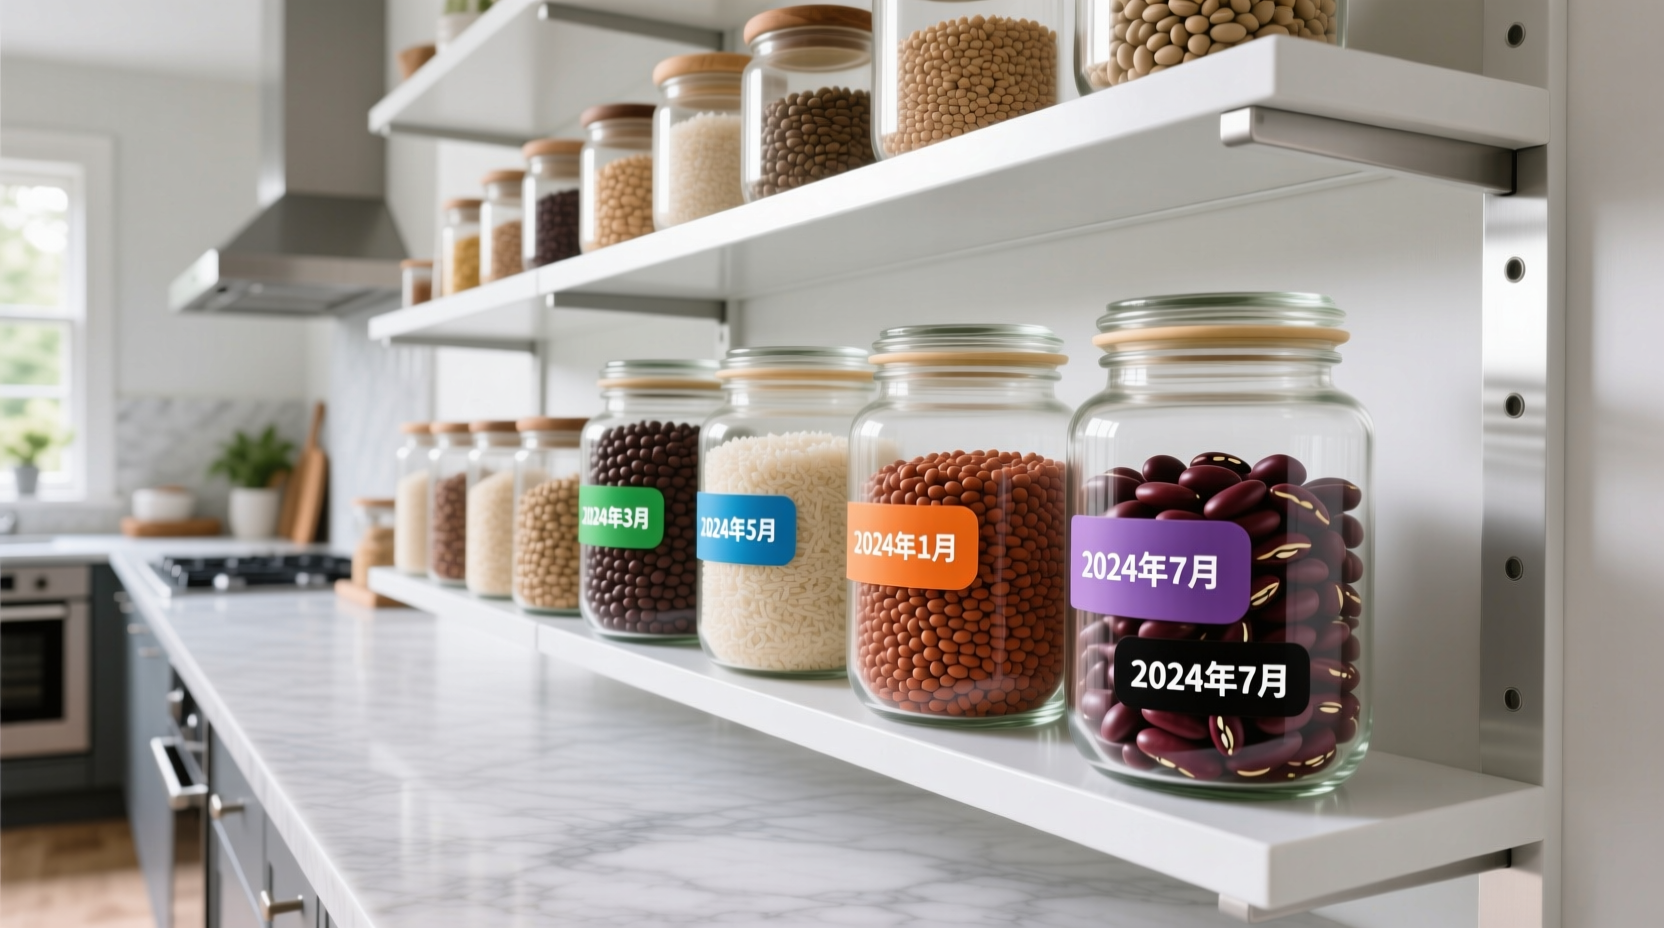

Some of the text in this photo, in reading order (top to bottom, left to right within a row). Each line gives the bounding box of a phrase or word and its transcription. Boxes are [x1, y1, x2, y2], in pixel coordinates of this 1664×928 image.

[581, 506, 648, 530] 2024年3月
[700, 516, 775, 542] 2024年5月
[853, 531, 956, 563] 2024年1月
[1081, 550, 1218, 590] 2024年7月
[1130, 659, 1288, 699] 2024年7月
